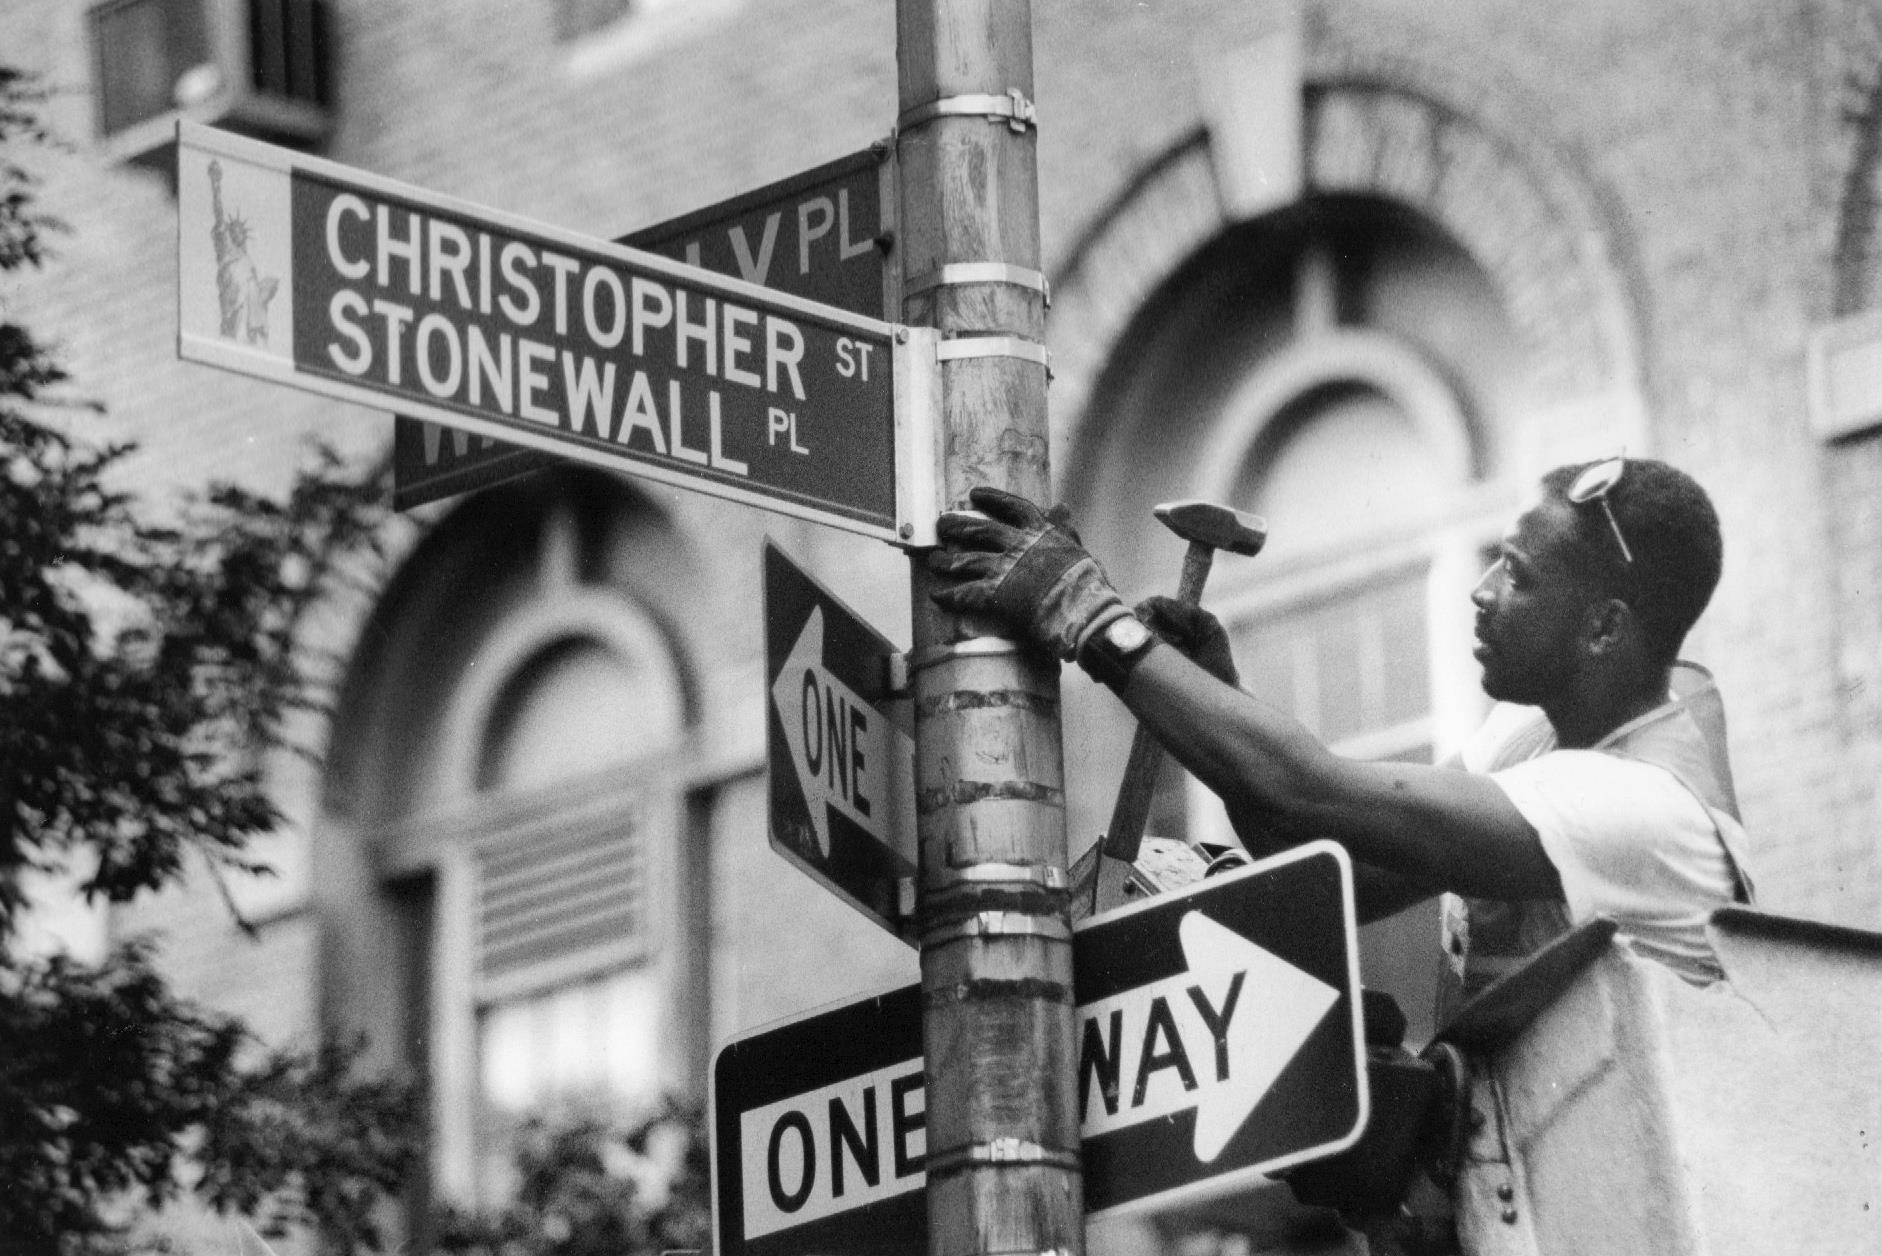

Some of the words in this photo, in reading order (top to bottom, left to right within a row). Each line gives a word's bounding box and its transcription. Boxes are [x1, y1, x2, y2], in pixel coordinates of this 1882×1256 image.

[326, 193, 806, 400] CHRISTOPHER
[835, 337, 873, 382] ST
[798, 188, 874, 275] PL
[328, 289, 748, 476] STONEWALL
[768, 407, 809, 455] PL
[802, 667, 871, 818] ONE
[767, 1070, 927, 1214] ONE
